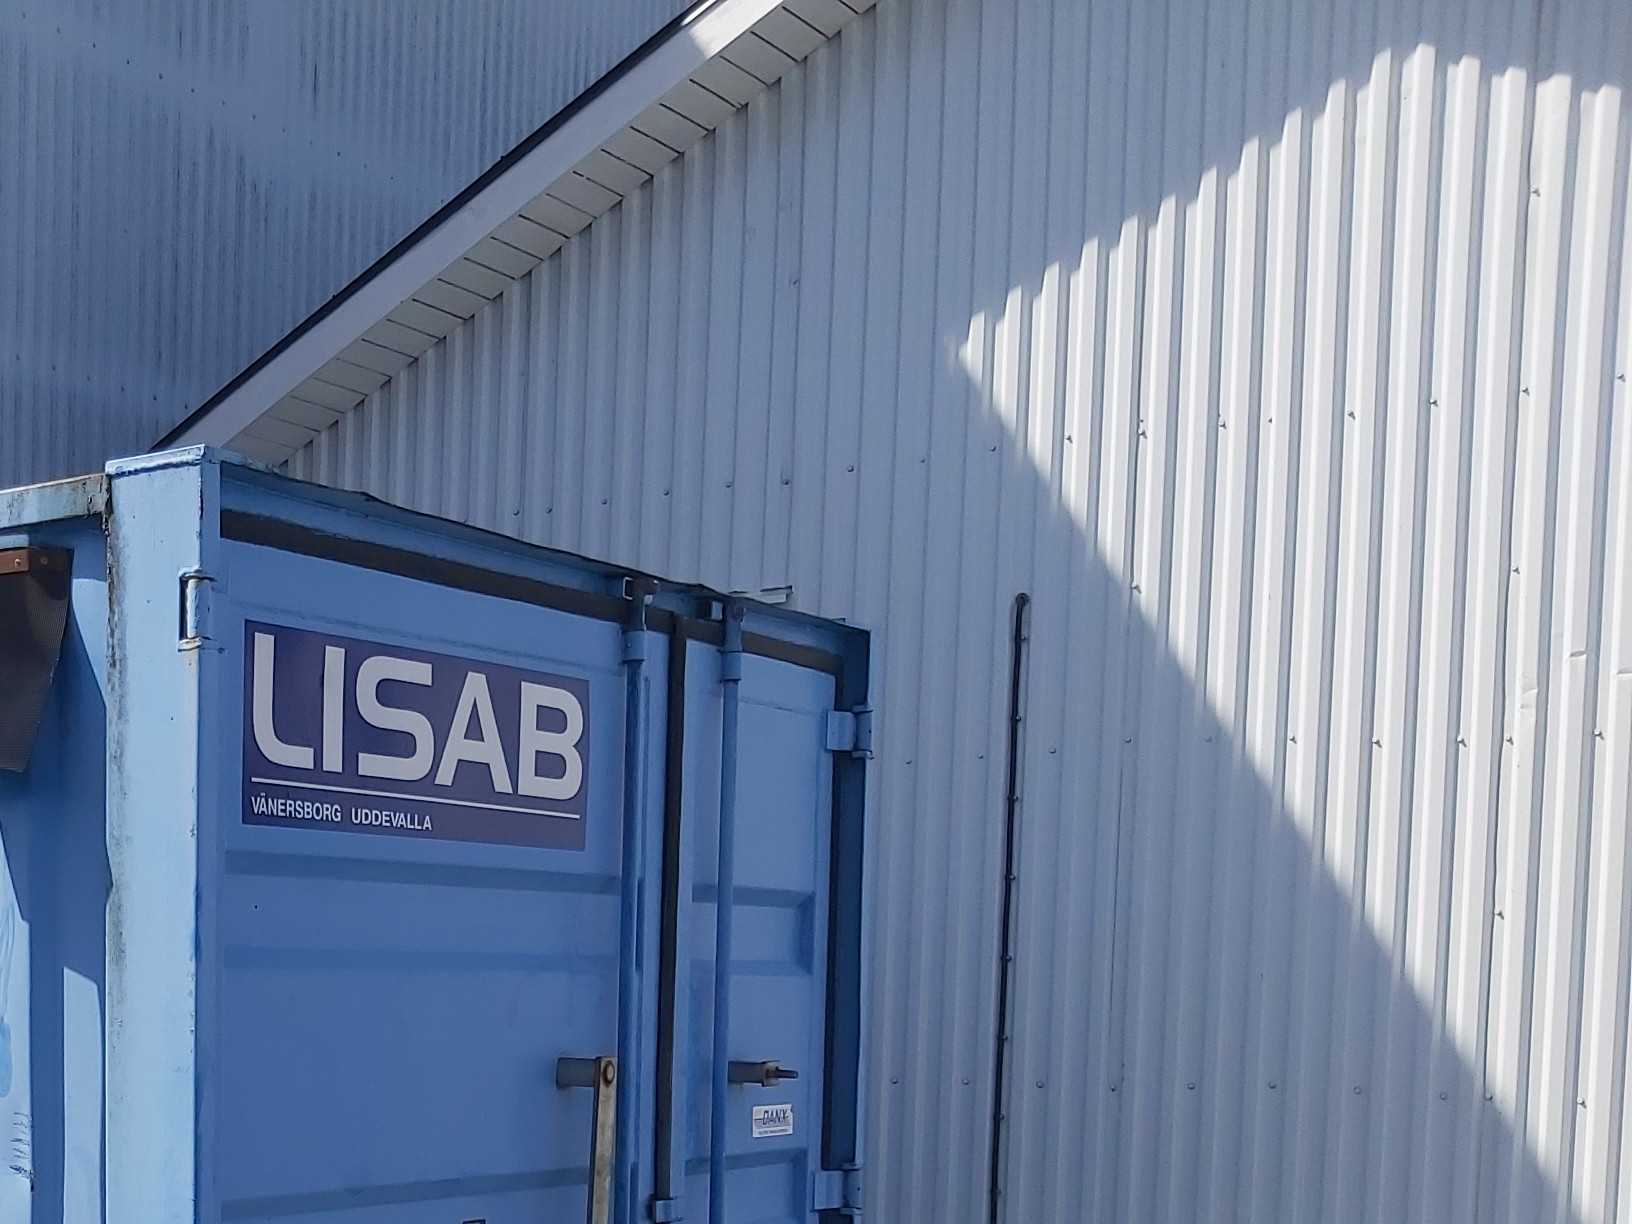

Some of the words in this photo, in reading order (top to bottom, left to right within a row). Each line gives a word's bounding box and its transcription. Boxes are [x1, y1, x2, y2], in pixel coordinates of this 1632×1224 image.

[253, 631, 584, 800] LISAB
[251, 793, 342, 823] VÄNERSBORG
[351, 807, 433, 832] UDDEVALLA
